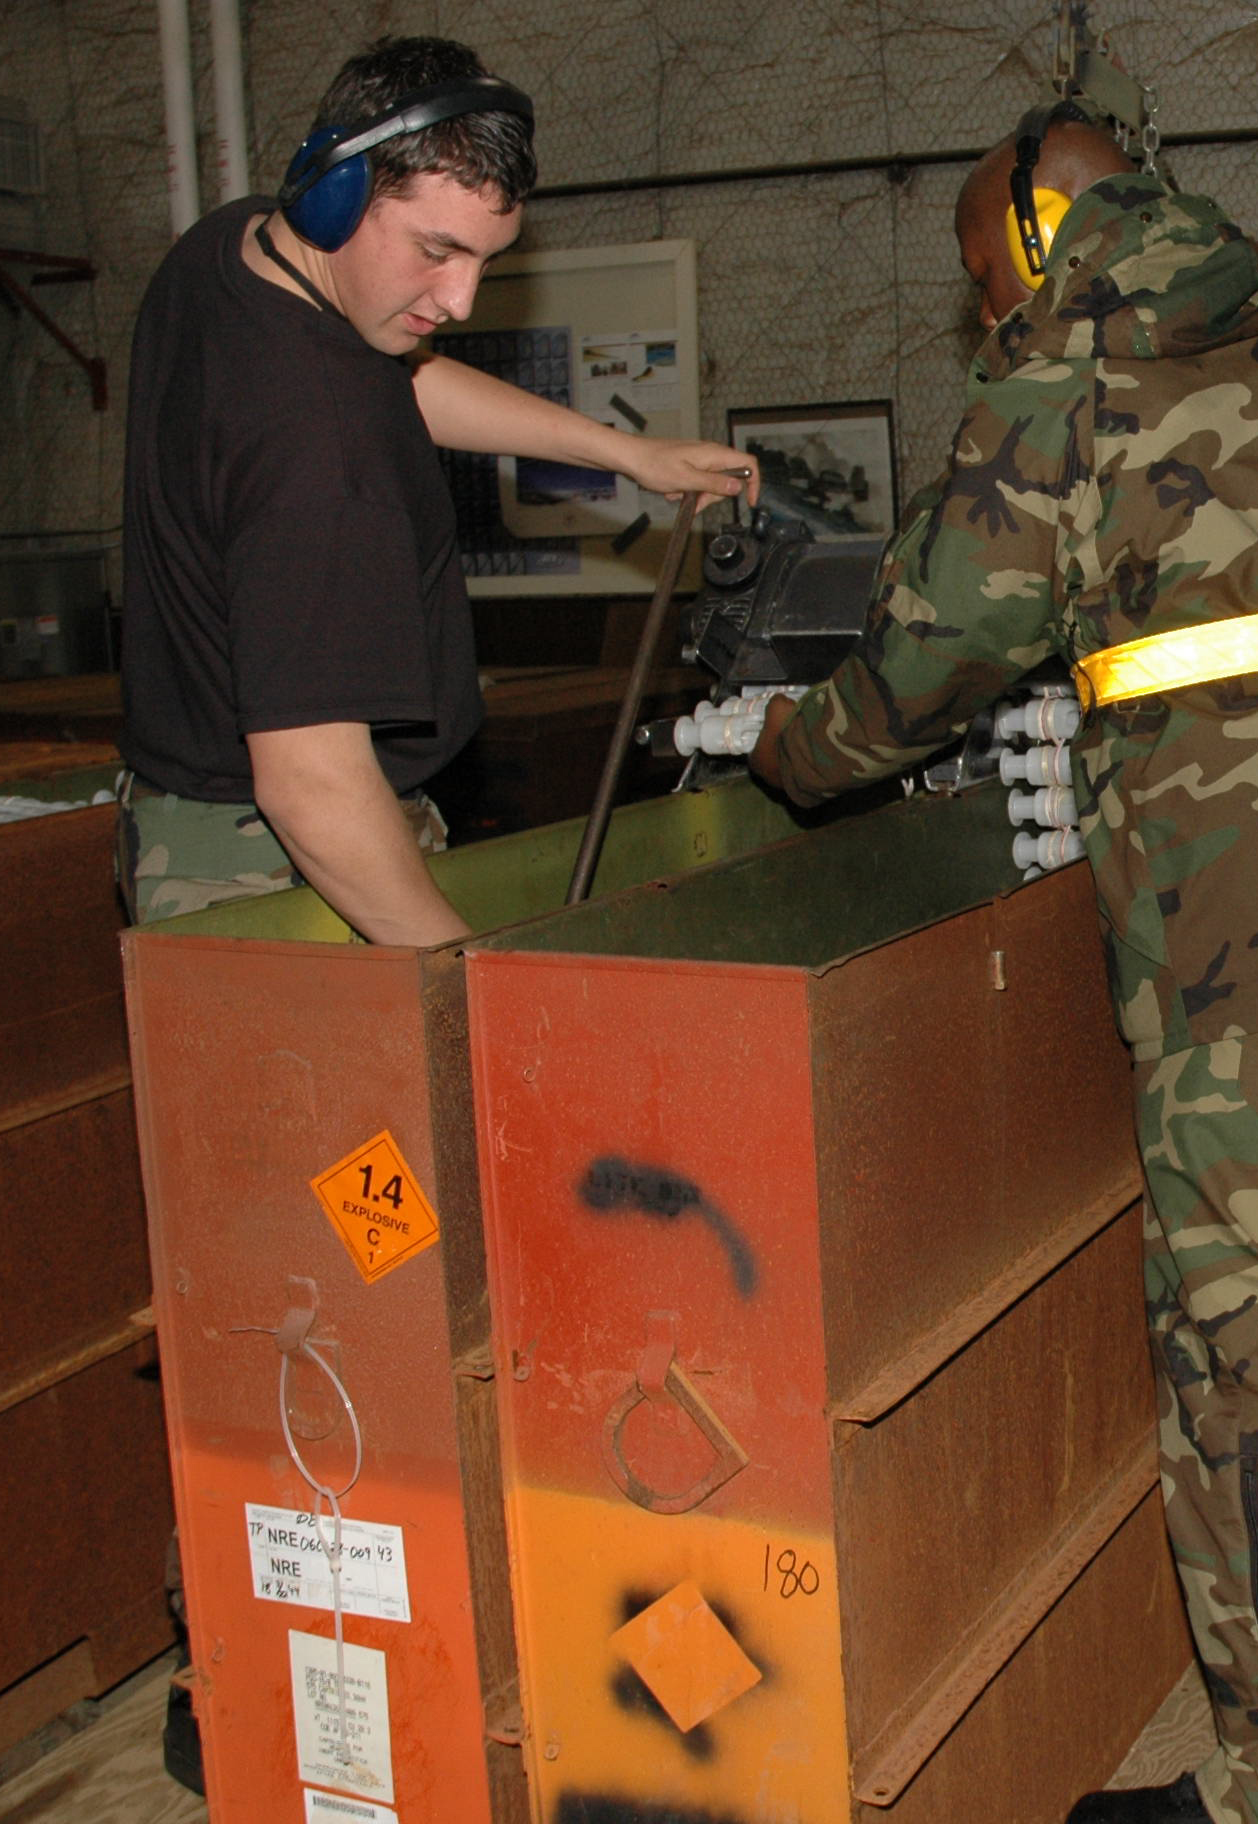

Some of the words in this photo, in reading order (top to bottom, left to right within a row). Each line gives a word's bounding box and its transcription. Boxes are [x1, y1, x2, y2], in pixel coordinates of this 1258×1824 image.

[359, 1164, 404, 1210] 1.4
[342, 1200, 410, 1235] EXPLOSIVE
[366, 1228, 381, 1246] C
[368, 1251, 375, 1265] 1
[377, 1544, 393, 1562] 43
[271, 1557, 302, 1578] NRE
[763, 1543, 820, 1599] 180
